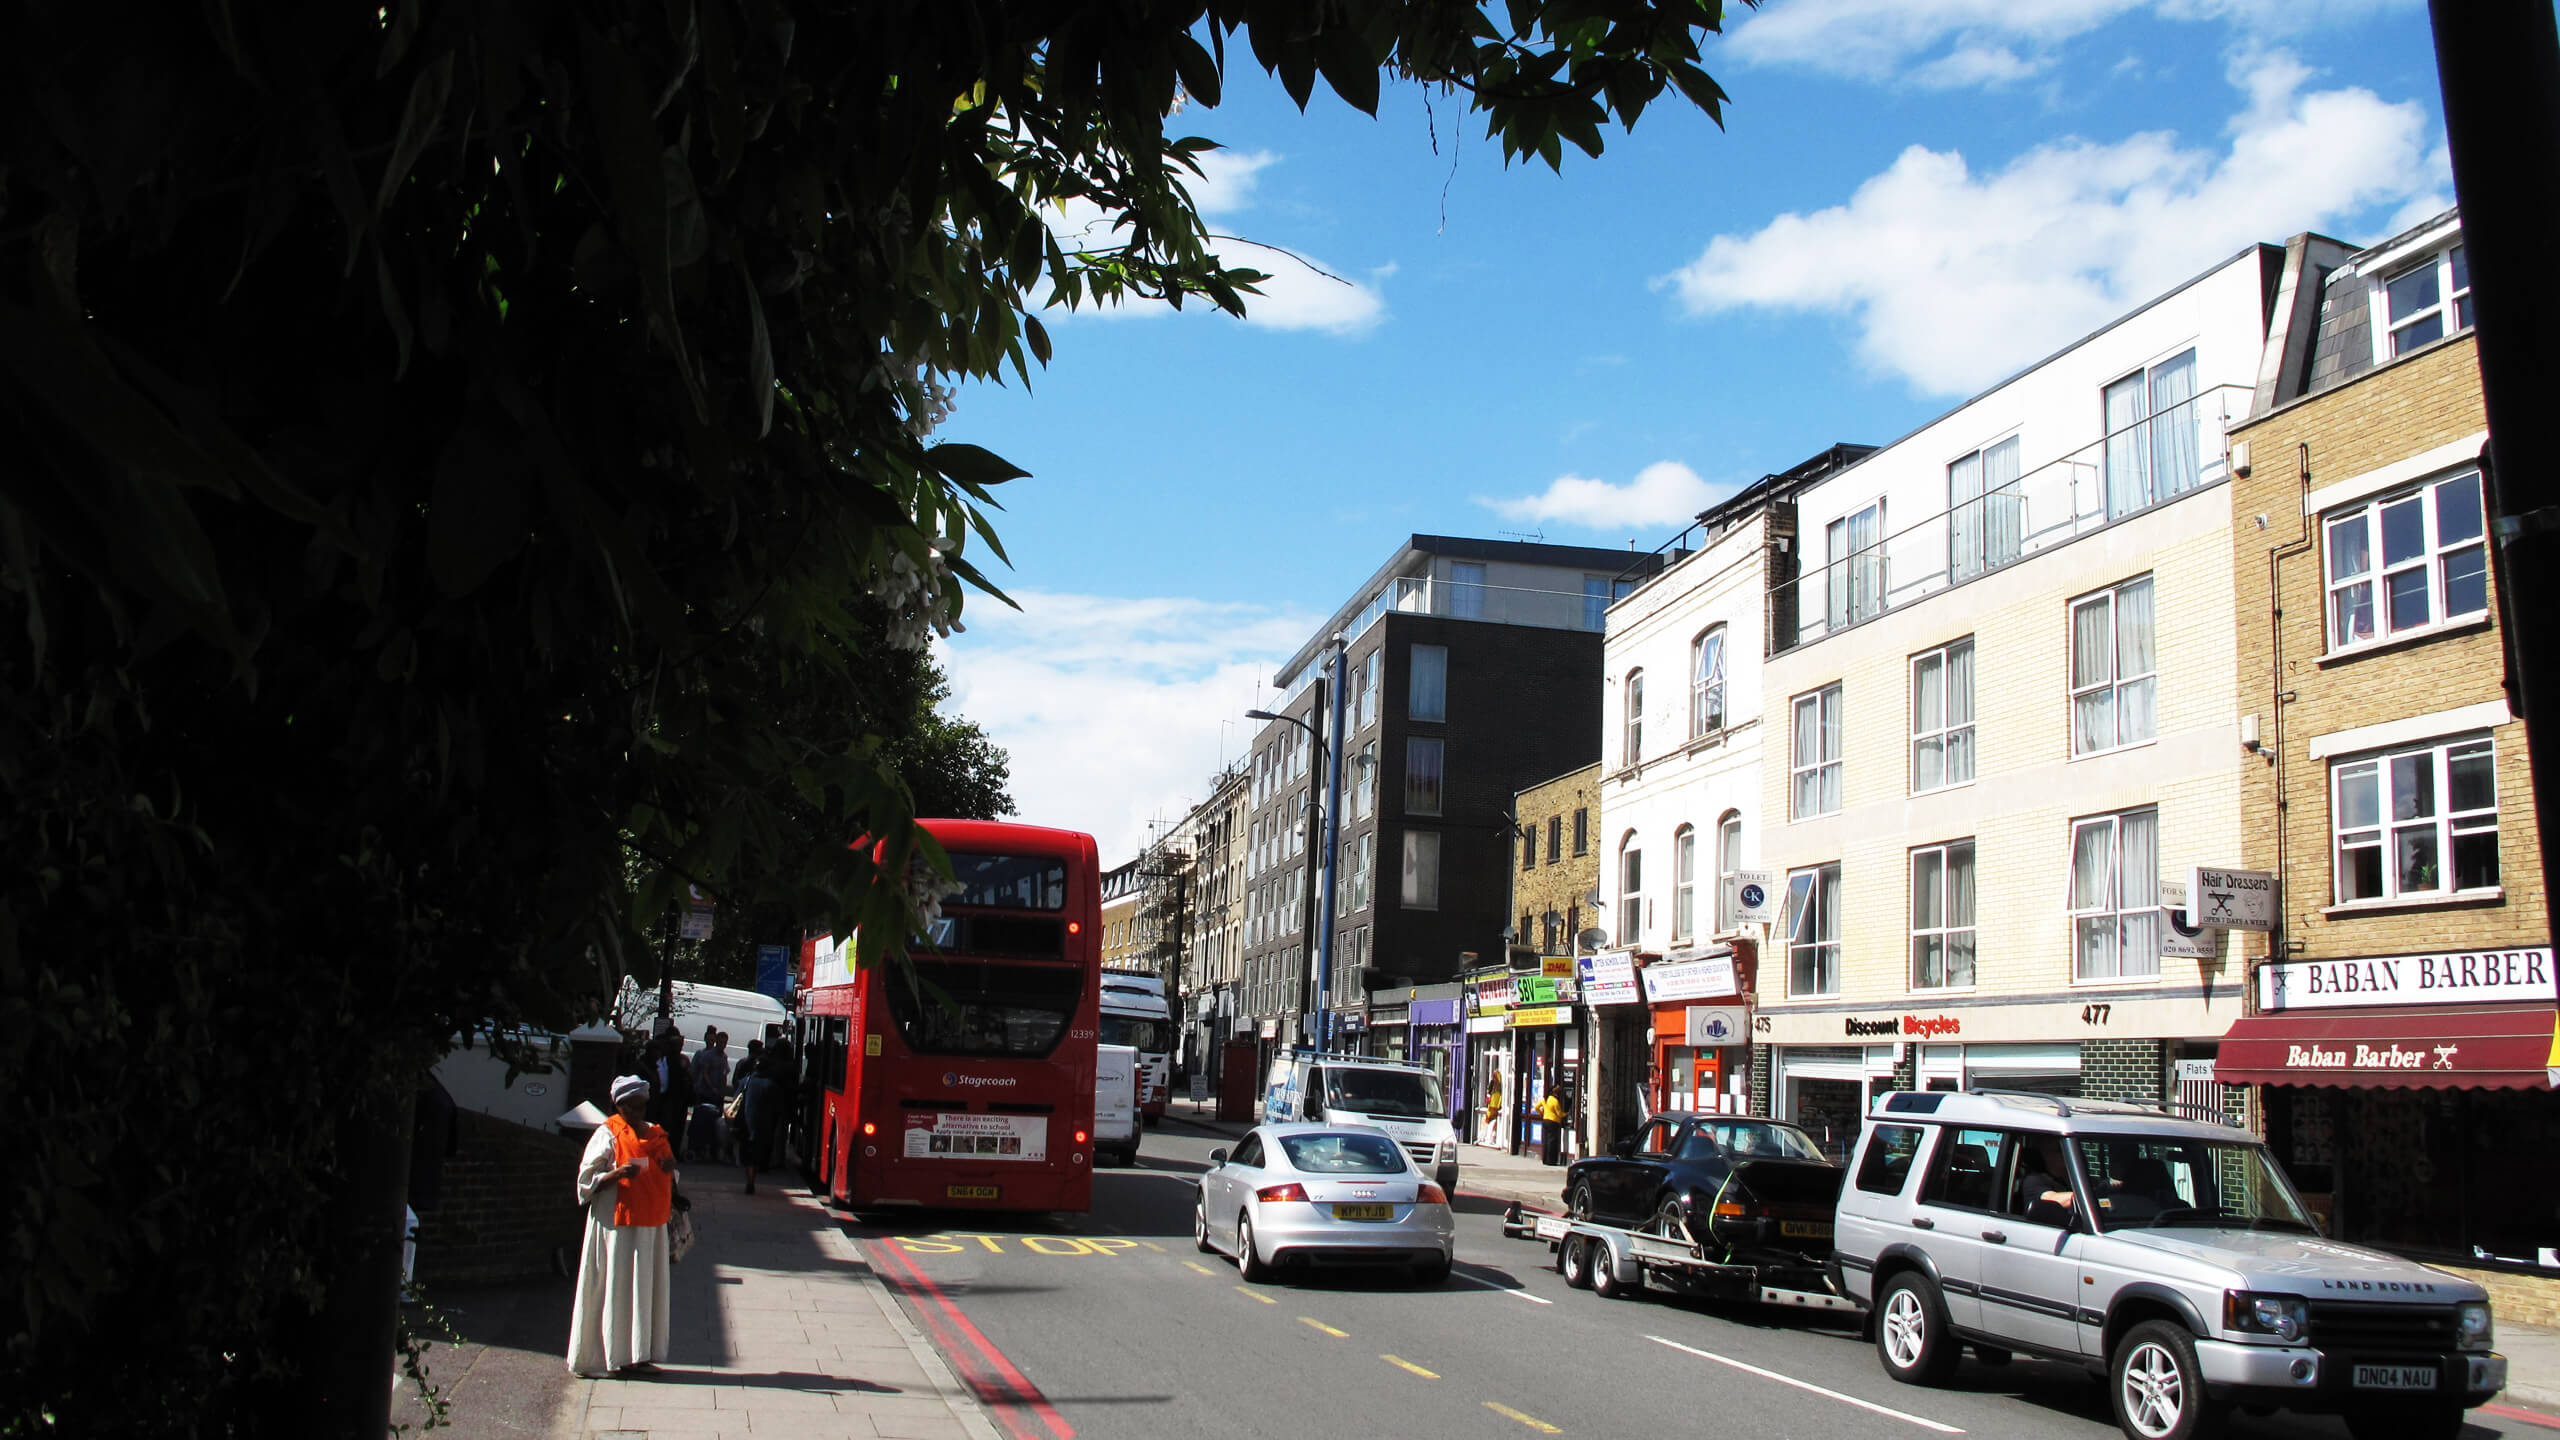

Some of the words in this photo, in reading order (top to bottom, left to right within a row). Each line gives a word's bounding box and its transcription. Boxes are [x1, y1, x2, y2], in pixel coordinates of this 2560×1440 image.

[1740, 872, 1750, 880] TO
[1751, 873, 1766, 881] LET
[2202, 872, 2222, 888] Hair
[2226, 874, 2269, 890] Dressers
[2162, 887, 2177, 895] FOR
[2163, 945, 2177, 953] 020
[2178, 946, 2195, 954] 8692
[2307, 960, 2400, 995] BABAN
[2418, 951, 2548, 990] BARBER
[1517, 977, 1536, 1002] SBV
[2082, 1004, 2112, 1026] 477
[1755, 1016, 1771, 1033] 475
[1845, 1018, 1900, 1036] Discount
[1903, 1015, 1960, 1038] Bicycles
[1071, 1029, 1095, 1039] 12339
[2286, 1044, 2346, 1068] Baban
[2353, 1043, 2426, 1069] Barber
[2186, 1063, 2208, 1075] Flats
[958, 1074, 1017, 1088] Stagecoach
[945, 1114, 964, 1122] There
[982, 1115, 1009, 1124] exciting
[989, 1123, 1011, 1131] school
[894, 1234, 1139, 1257] STOP
[2322, 1279, 2371, 1291] LAND
[2376, 1281, 2436, 1294] ROVER
[2358, 1367, 2399, 1386] DN04
[2401, 1369, 2432, 1387] NAU
